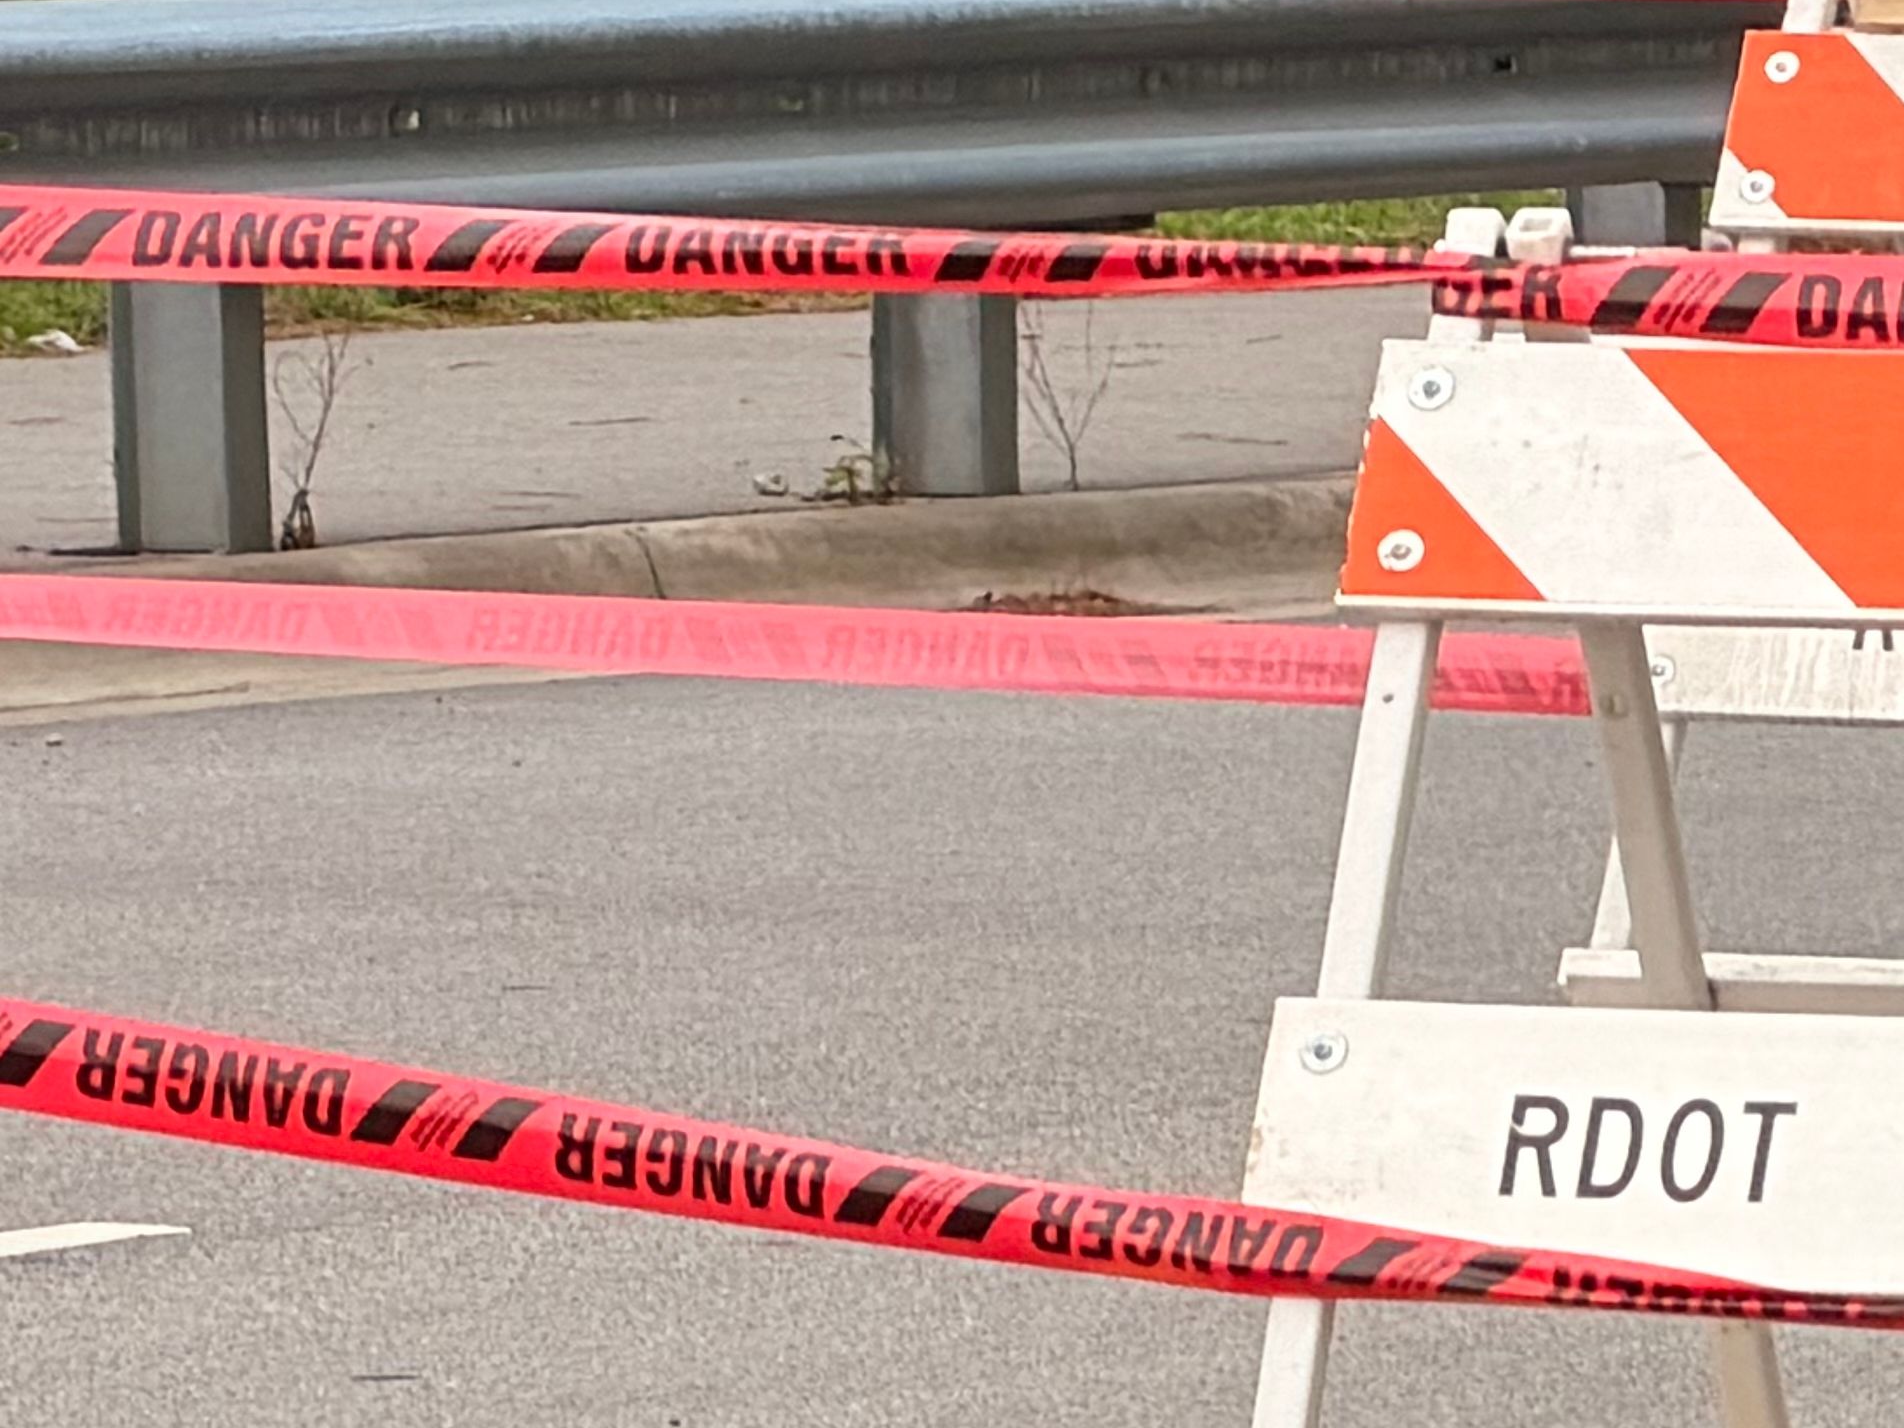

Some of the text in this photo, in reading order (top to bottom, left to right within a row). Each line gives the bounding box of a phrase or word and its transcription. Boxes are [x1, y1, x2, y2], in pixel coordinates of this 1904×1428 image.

[131, 209, 420, 271] DANGER
[75, 1026, 1325, 1279] DANGER DANGER DANGER
[1498, 1093, 1799, 1203] RDOT
